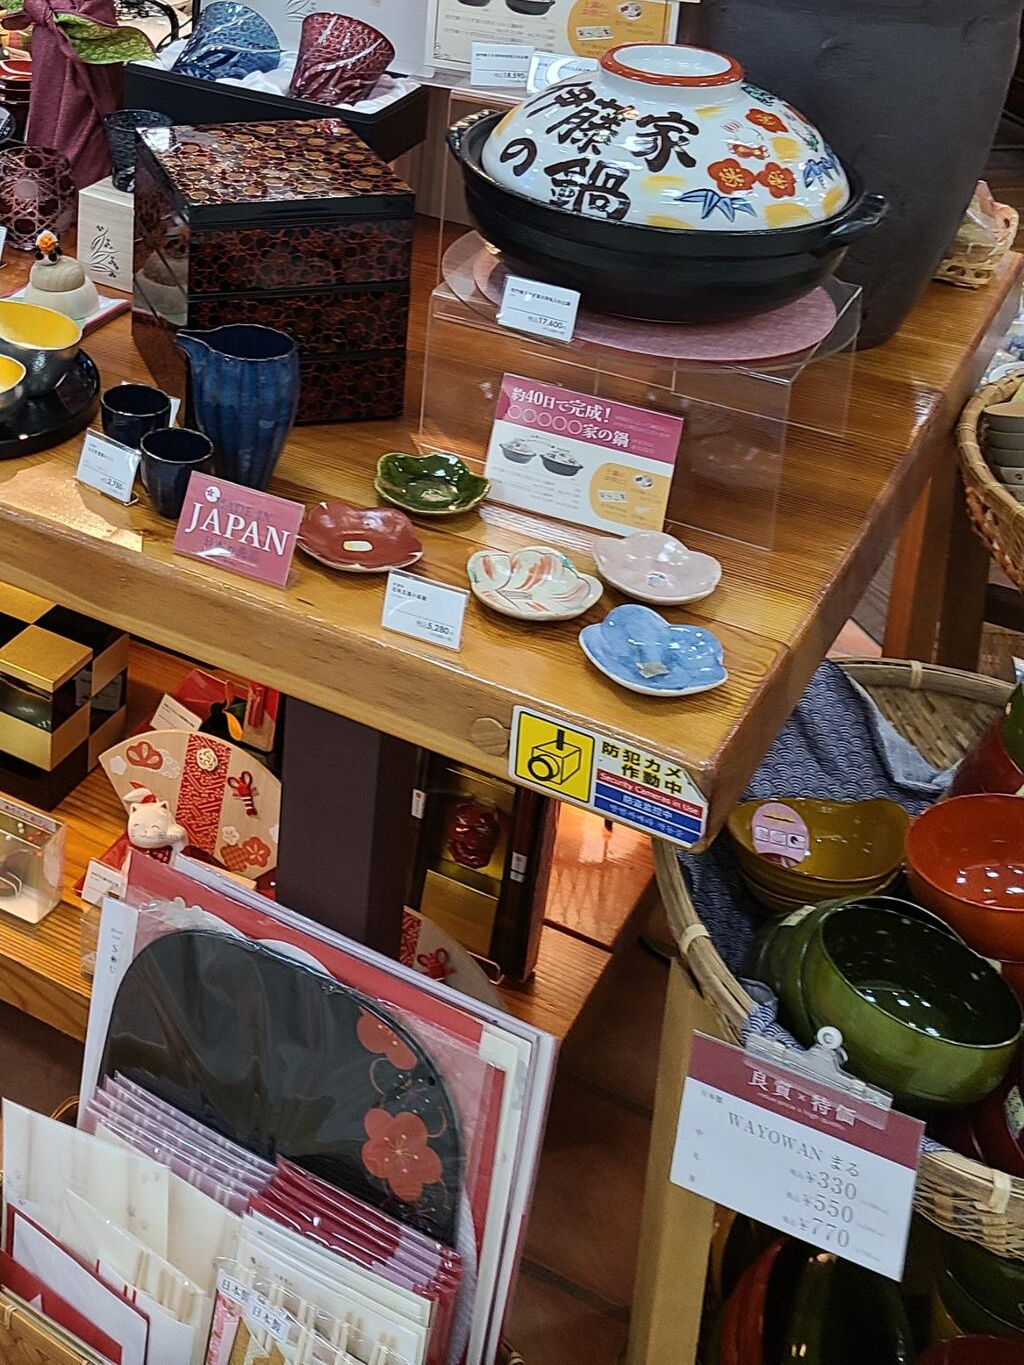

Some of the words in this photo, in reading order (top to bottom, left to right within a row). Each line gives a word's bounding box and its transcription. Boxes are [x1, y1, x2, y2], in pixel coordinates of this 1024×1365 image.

[185, 502, 290, 556] JAPAN
[602, 741, 682, 778] 防犯カメ
[622, 762, 682, 794] 作動中
[599, 772, 633, 791] Security
[634, 784, 672, 805] Cameras
[682, 802, 700, 815] Use
[728, 1111, 824, 1163] WAYOWAN
